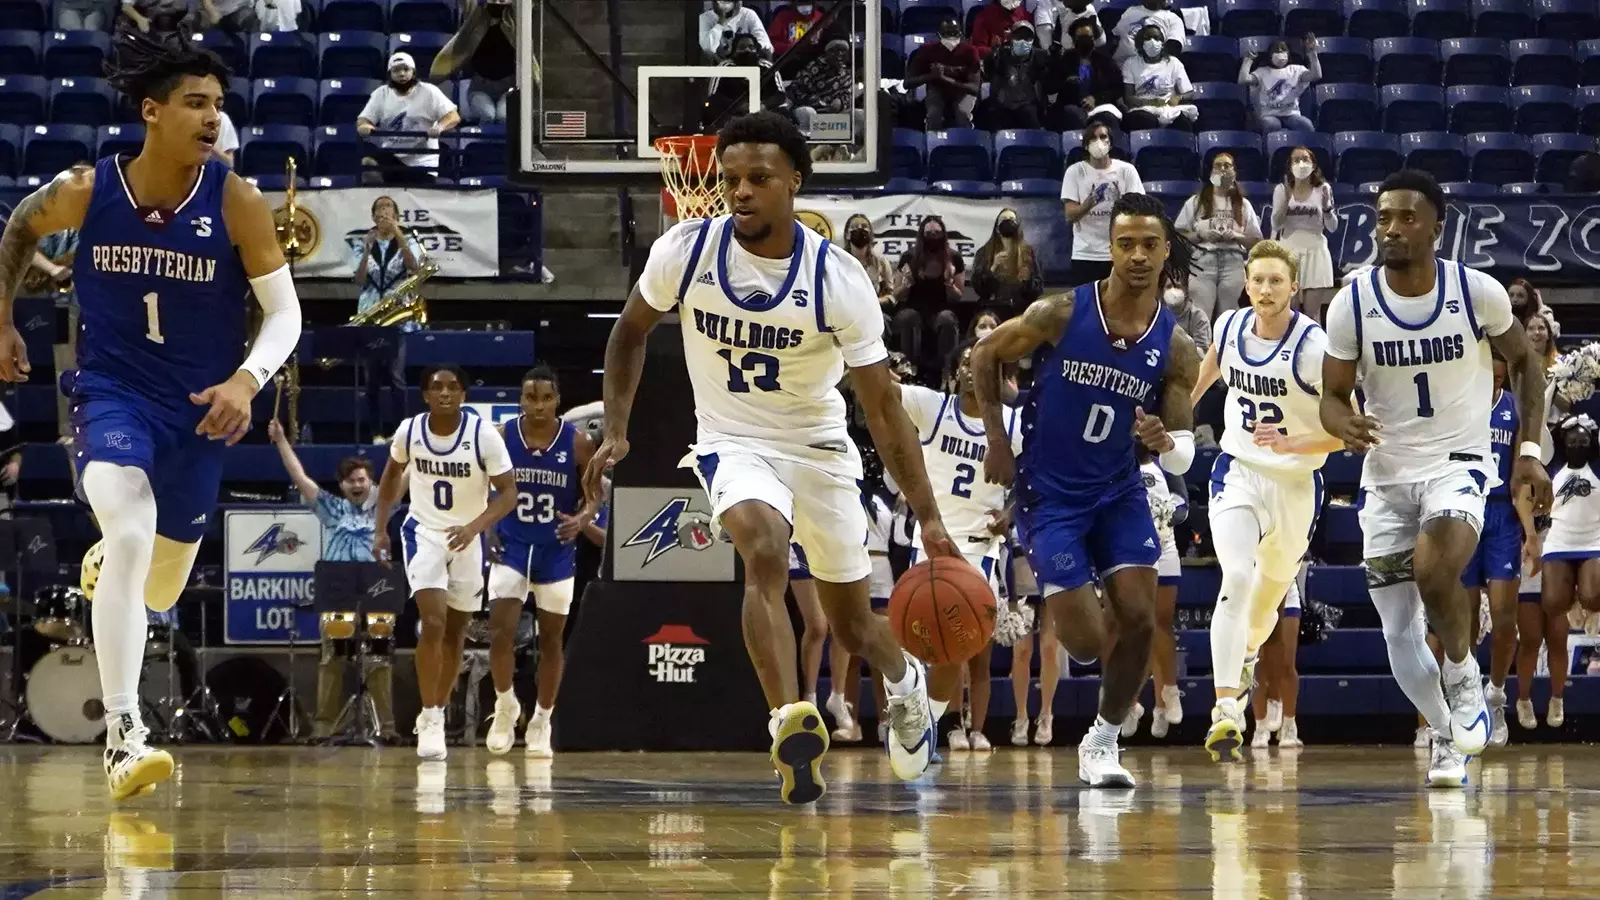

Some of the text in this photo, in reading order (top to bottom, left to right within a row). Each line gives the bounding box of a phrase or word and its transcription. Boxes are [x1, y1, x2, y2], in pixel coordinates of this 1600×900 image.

[812, 122, 848, 131] SOUTH
[398, 209, 430, 222] HE
[886, 214, 942, 227] TH
[92, 245, 216, 282] PRESBYTERIAN
[143, 291, 164, 344] 1
[693, 307, 804, 350] BULLDOGS
[1372, 333, 1464, 367] BULLDOGS
[716, 348, 782, 392] 13
[1228, 366, 1288, 397] BULLDOGS
[1413, 371, 1434, 417] 1
[1082, 403, 1116, 443] 0
[1237, 396, 1288, 436] 22
[940, 434, 986, 463] BULLDO
[415, 457, 471, 478] BULLDOGS
[511, 467, 568, 488] ESBYTERIAN
[951, 463, 976, 499] 2
[432, 480, 454, 511] 0
[516, 492, 555, 524] 23
[230, 578, 315, 602] BARKING
[256, 607, 295, 630] LOT
[648, 643, 706, 666] Pizza
[648, 661, 695, 683] Hut
